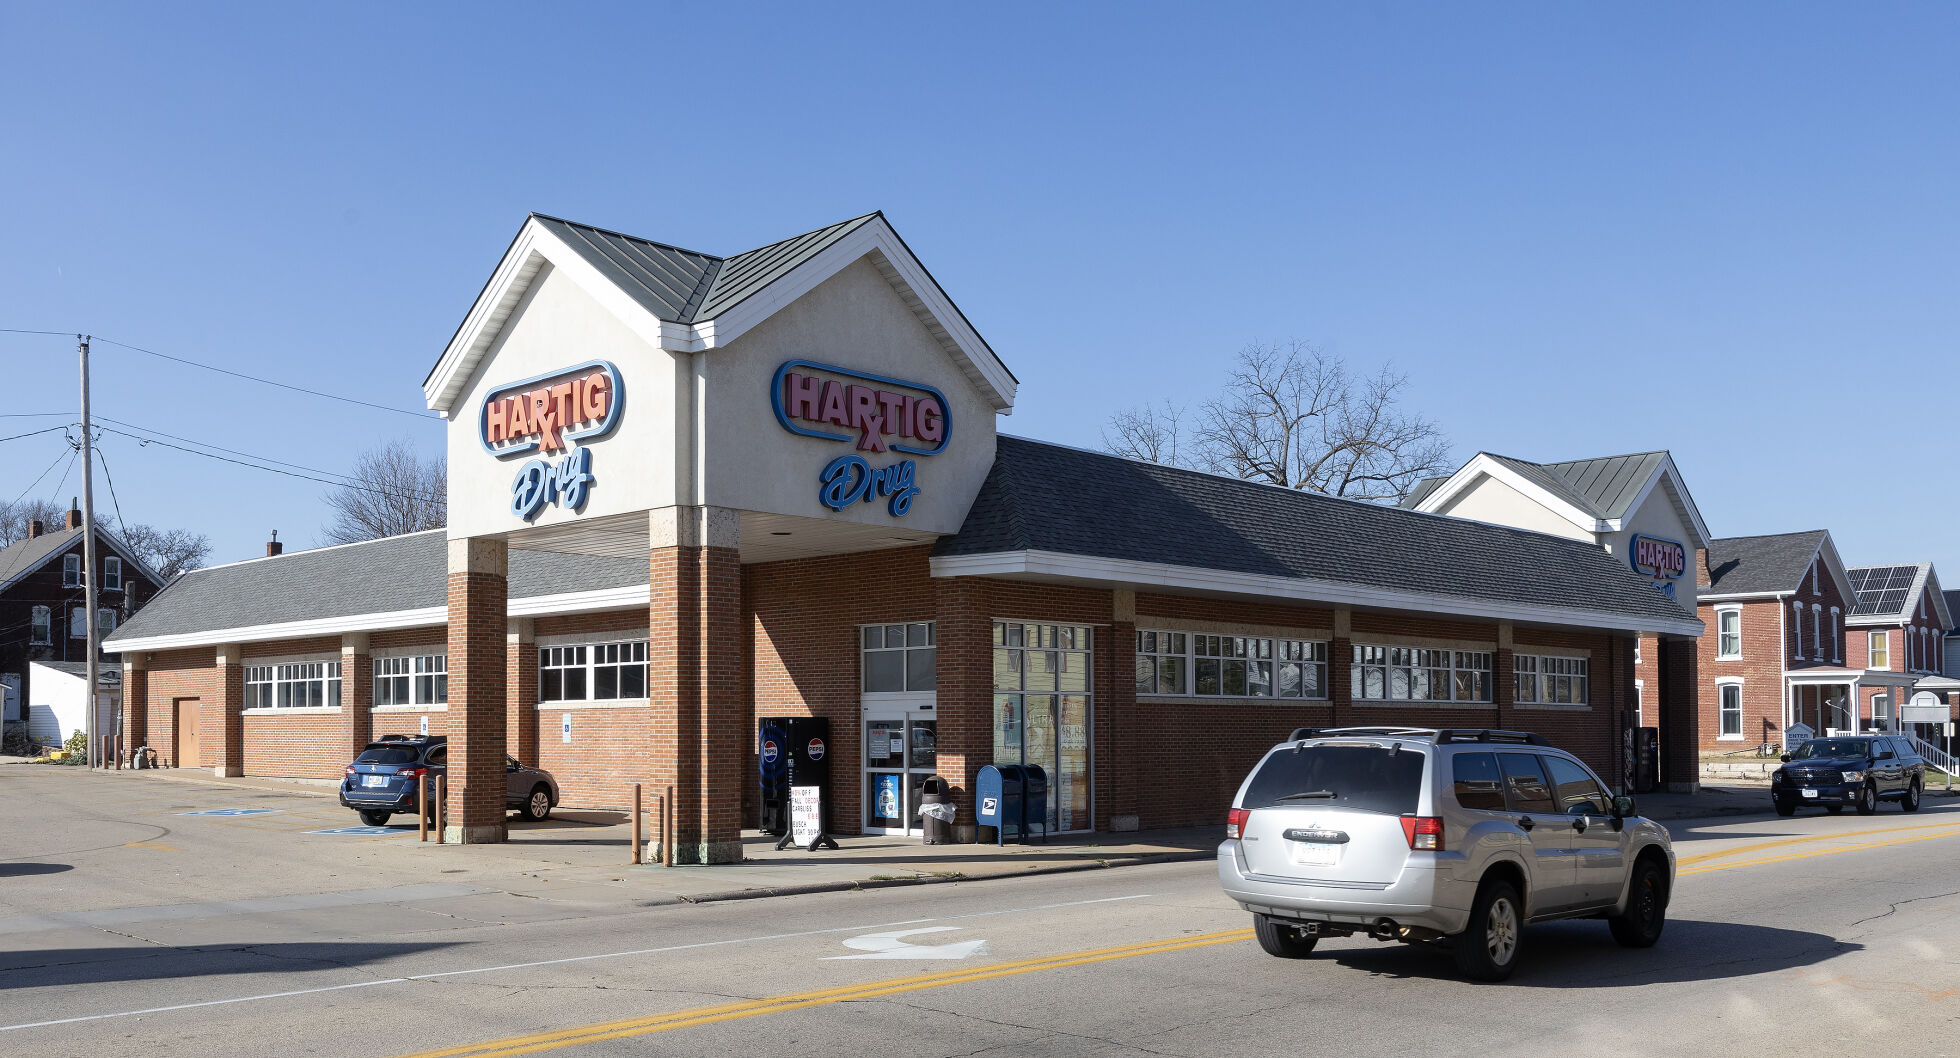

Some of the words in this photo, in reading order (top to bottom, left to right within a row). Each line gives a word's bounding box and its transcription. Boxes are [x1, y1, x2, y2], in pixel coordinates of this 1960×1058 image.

[487, 372, 612, 443] HARTIG
[785, 373, 943, 442] HARTIG
[511, 447, 594, 520] Drug
[819, 455, 921, 517] Drug
[1636, 540, 1683, 571] HARTIG
